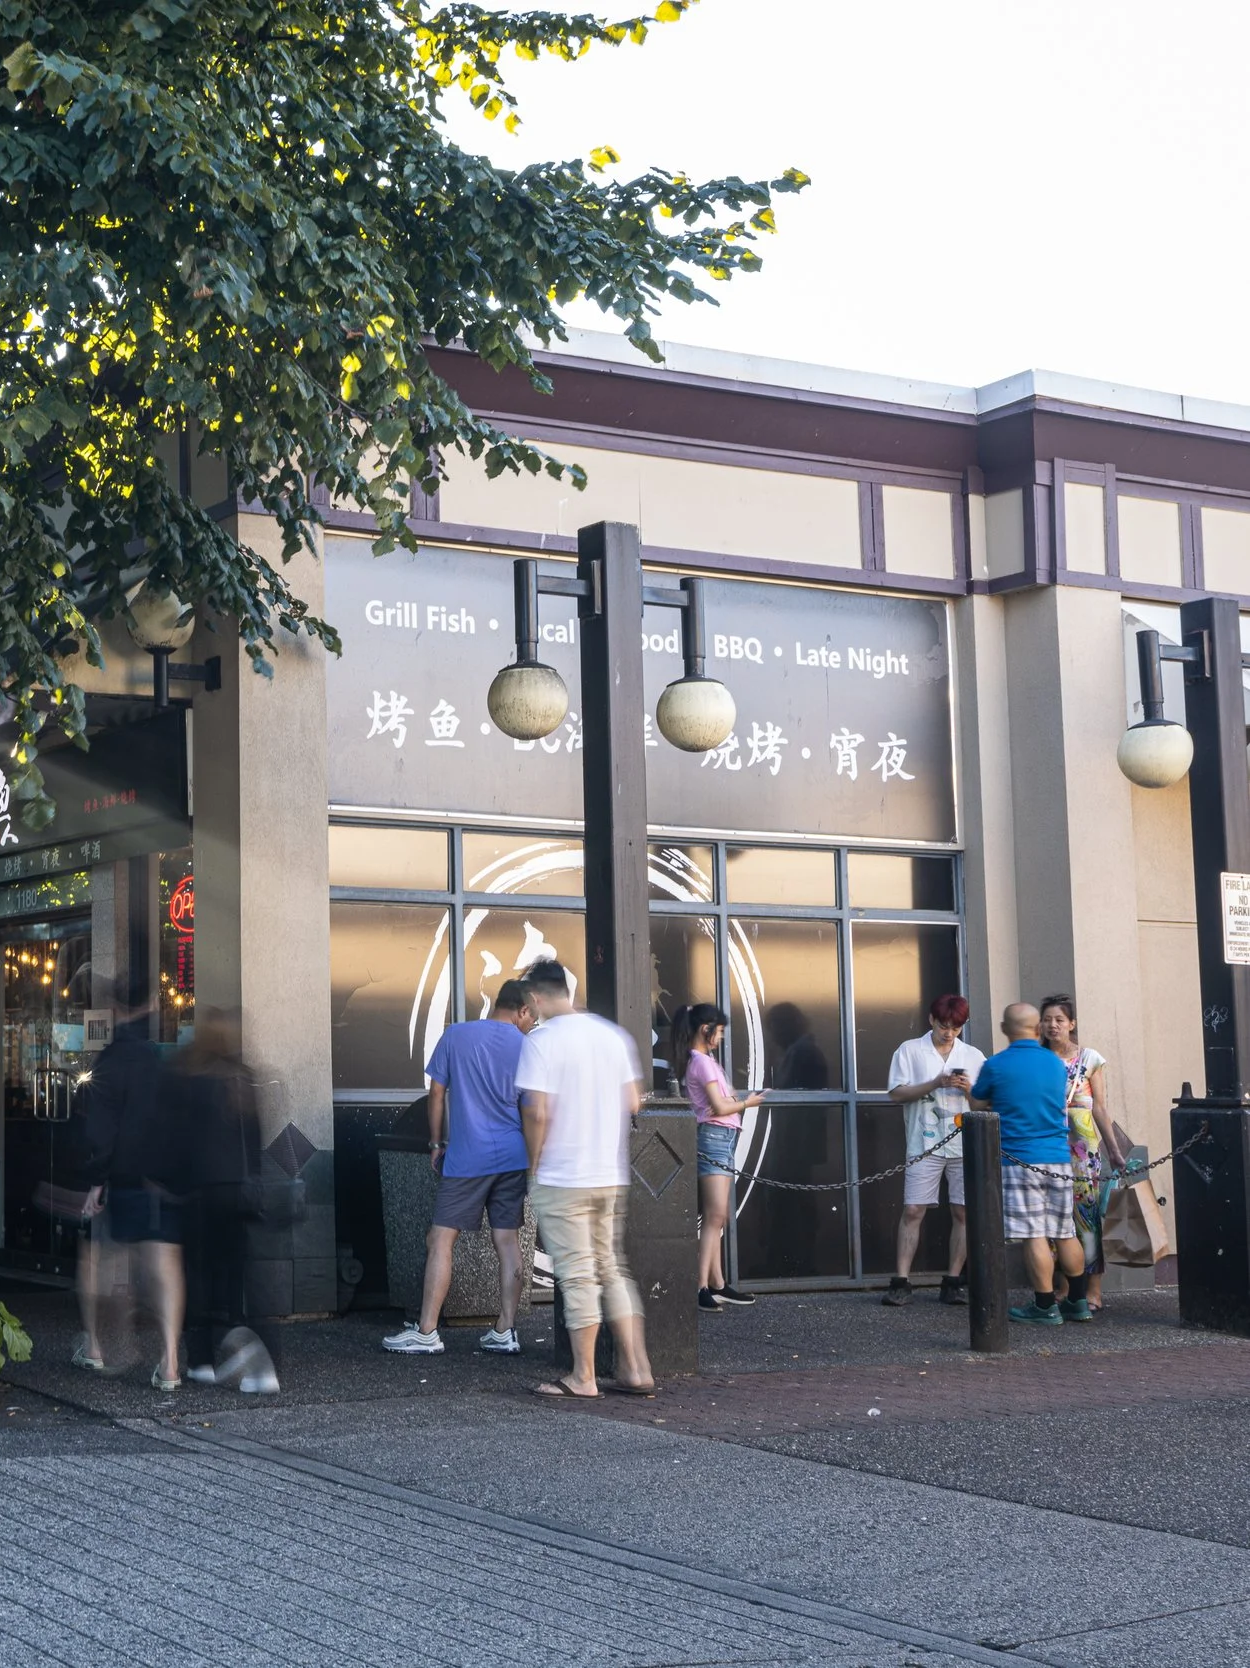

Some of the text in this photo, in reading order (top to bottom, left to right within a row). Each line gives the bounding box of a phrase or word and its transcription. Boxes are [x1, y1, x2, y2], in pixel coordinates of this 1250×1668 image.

[365, 599, 417, 628] Grill
[427, 605, 476, 634] Fish
[714, 634, 764, 664] BBQ
[796, 641, 841, 668] Late
[848, 647, 910, 679] Night
[366, 690, 466, 749] 烤鱼
[830, 727, 916, 782] 宵夜
[1225, 879, 1241, 891] FIRE
[16, 888, 37, 909] 1180
[1238, 895, 1248, 906] NO
